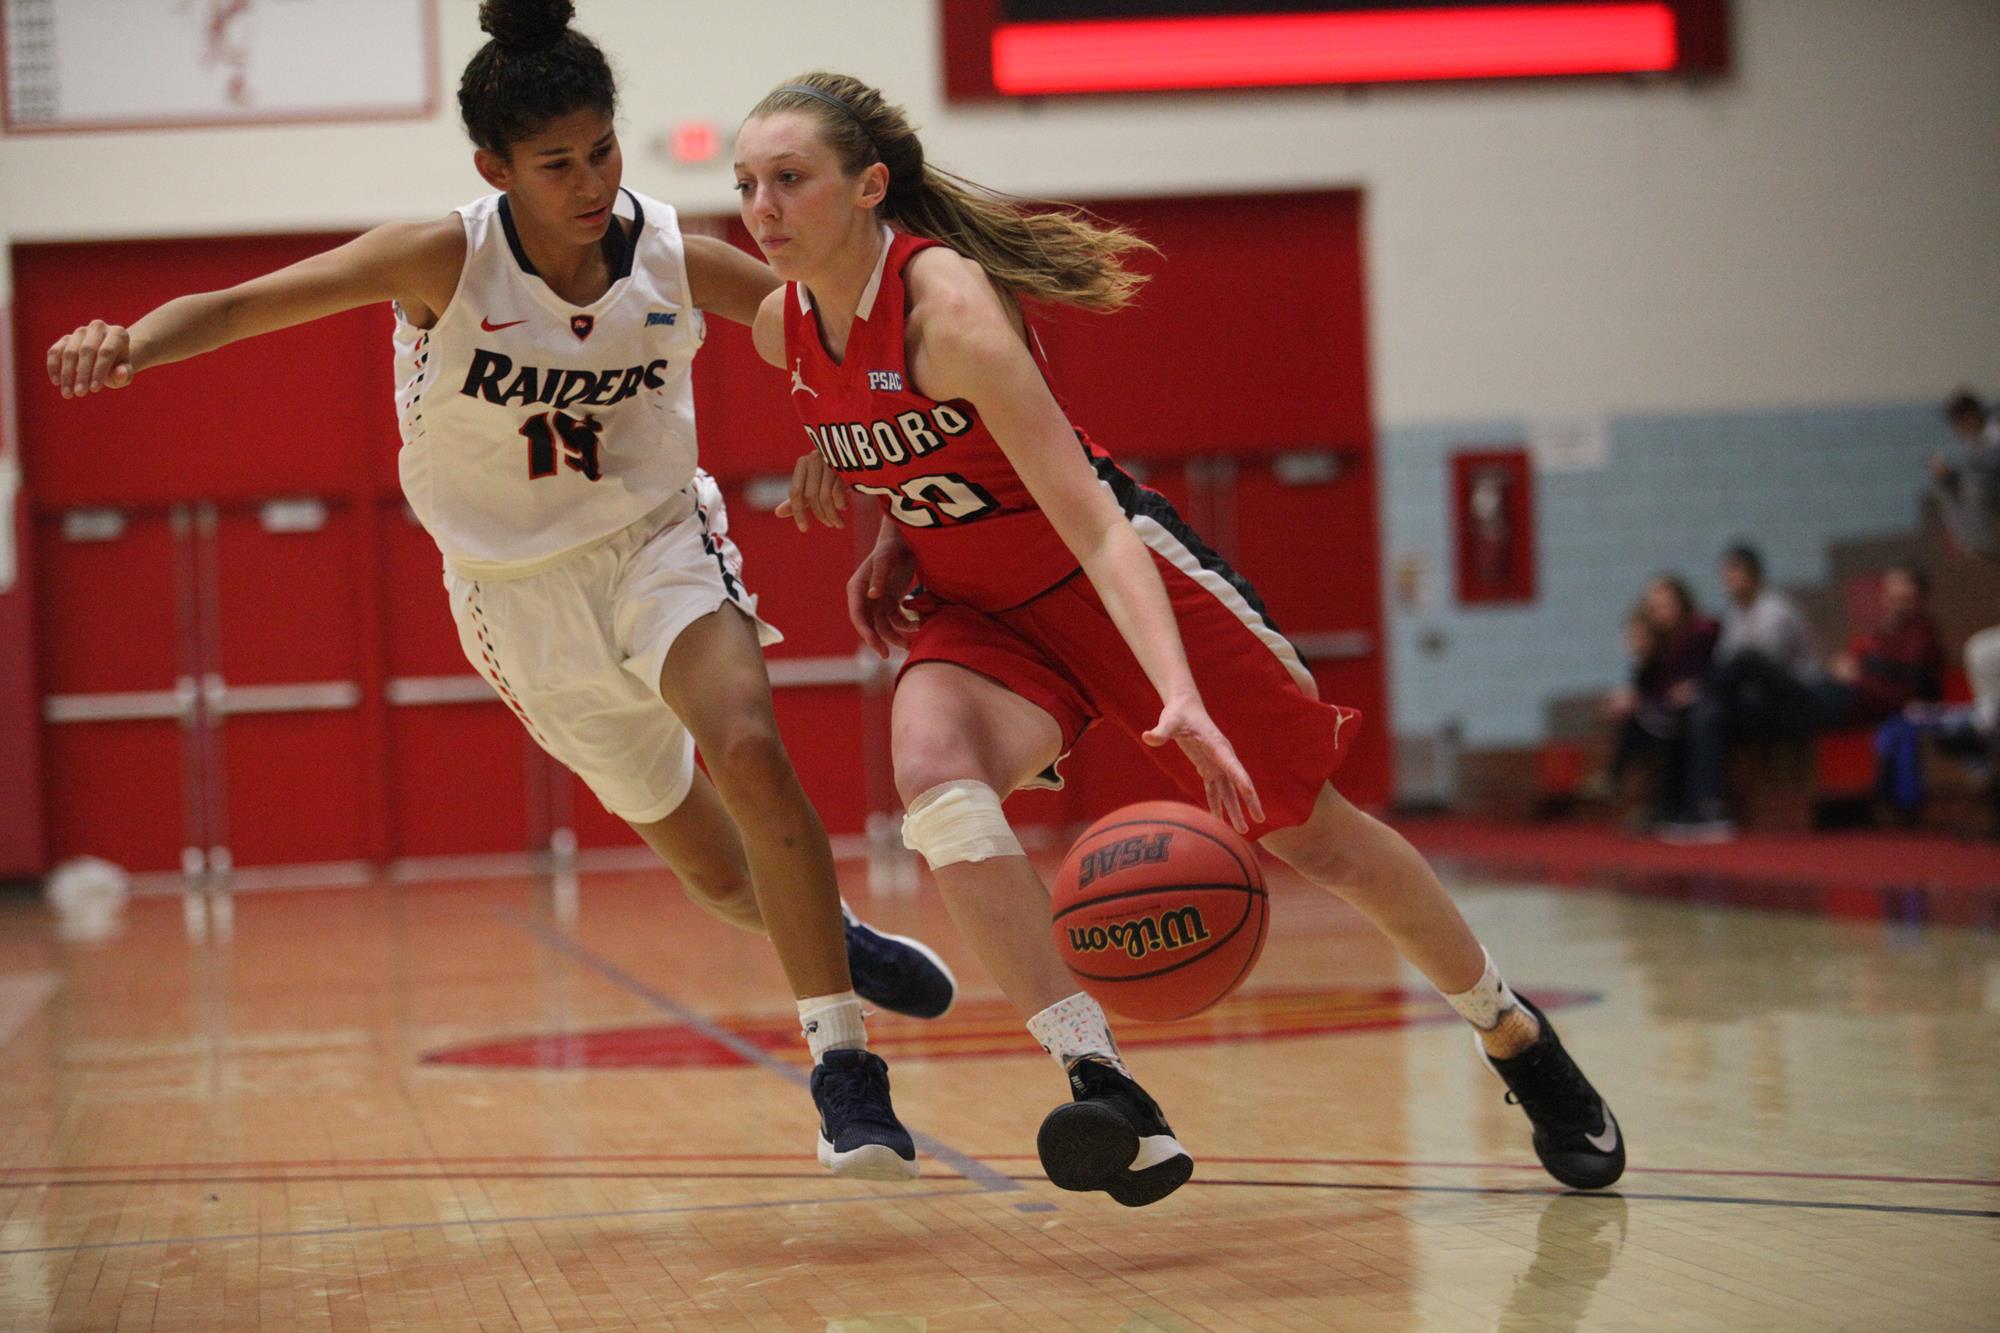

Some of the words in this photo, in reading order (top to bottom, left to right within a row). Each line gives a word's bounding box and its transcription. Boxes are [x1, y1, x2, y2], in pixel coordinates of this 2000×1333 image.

[459, 347, 669, 409] RAIDERS
[867, 370, 903, 392] PSAC
[1078, 832, 1174, 891] PSAC
[1067, 904, 1211, 960] Wilson
